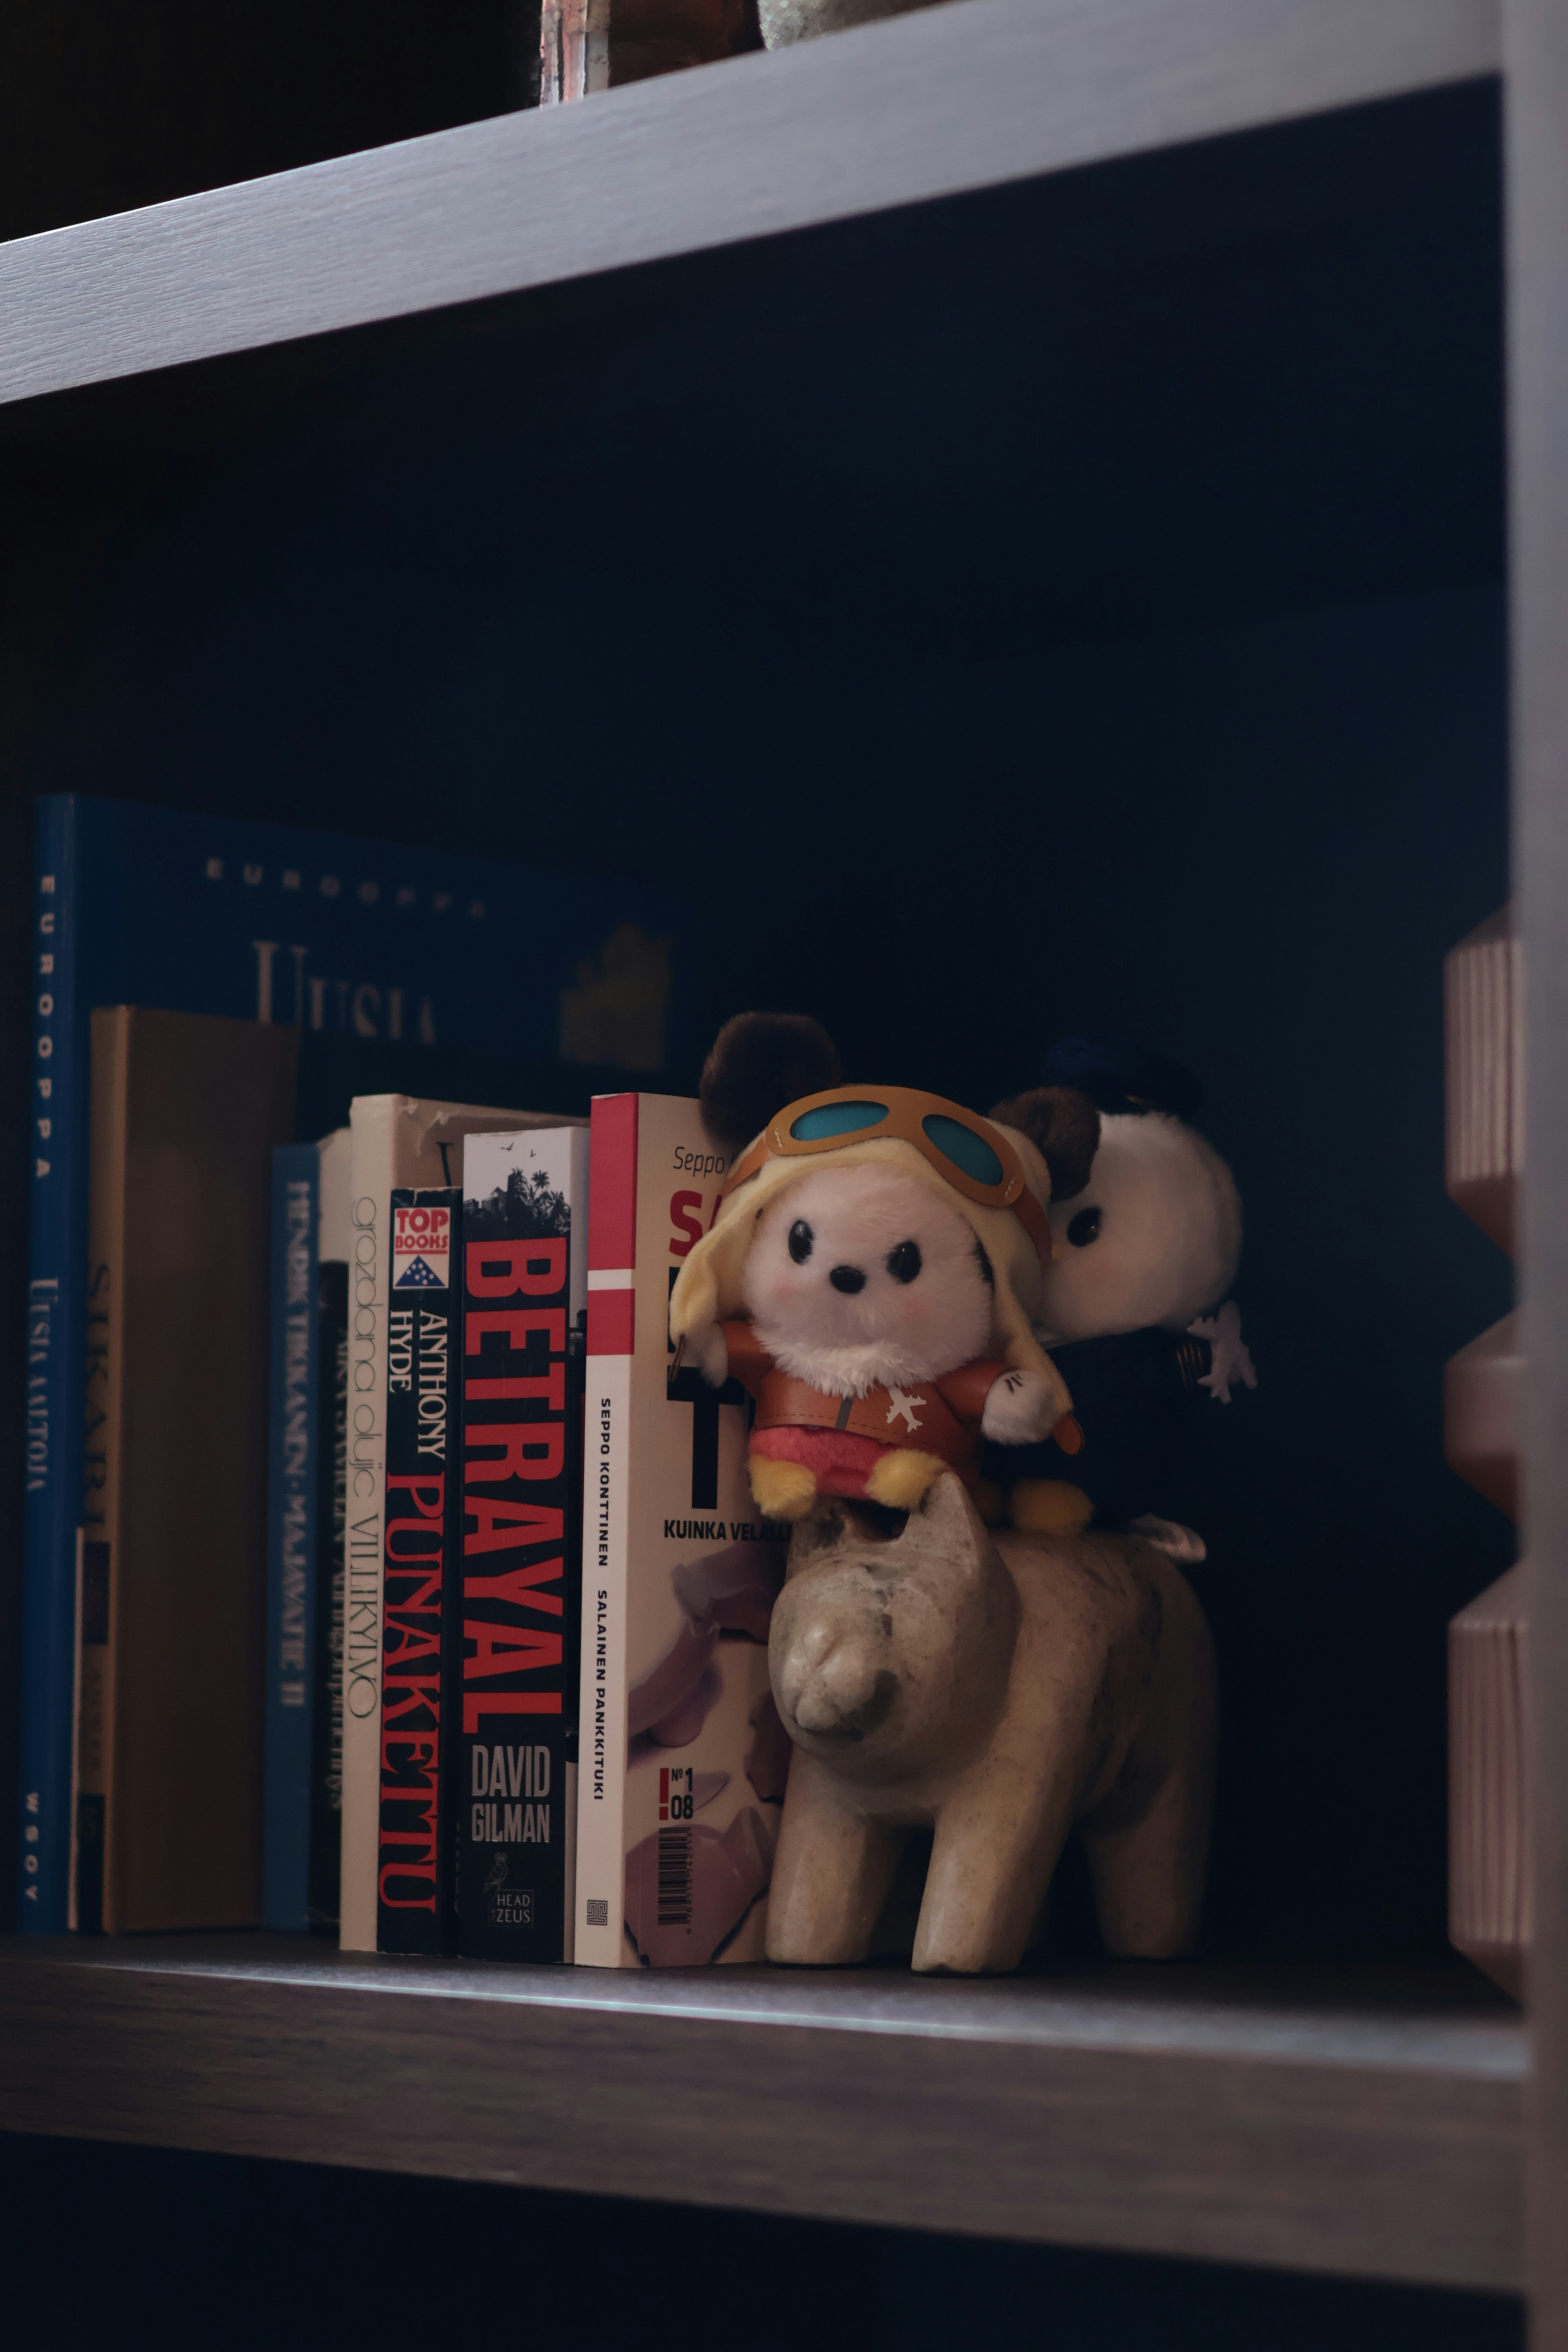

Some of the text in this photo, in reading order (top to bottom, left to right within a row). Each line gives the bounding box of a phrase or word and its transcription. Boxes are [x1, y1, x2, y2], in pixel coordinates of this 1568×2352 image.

[36, 875, 56, 1178] EUROOPPA
[673, 1146, 725, 1178] Seppo
[395, 1234, 448, 1249] BOOKS
[396, 1209, 449, 1233] TOP
[351, 1197, 383, 1391] grozdana
[389, 1310, 413, 1393] HYDE
[417, 1310, 448, 1460] ANTHONY
[463, 1237, 567, 1734] BETRAYAL
[664, 1519, 727, 1540] KUINKA
[594, 1399, 610, 1800] SEPPO KONTTINEN SALAINEN PANKKITUKI
[378, 1471, 445, 1915] PUNAKETTU
[472, 1744, 551, 1797] DAVID
[472, 1803, 550, 1843] GILMAN
[671, 1794, 693, 1820] 08
[496, 1909, 530, 1923] ZEUS
[497, 1894, 530, 1906] HEAD
